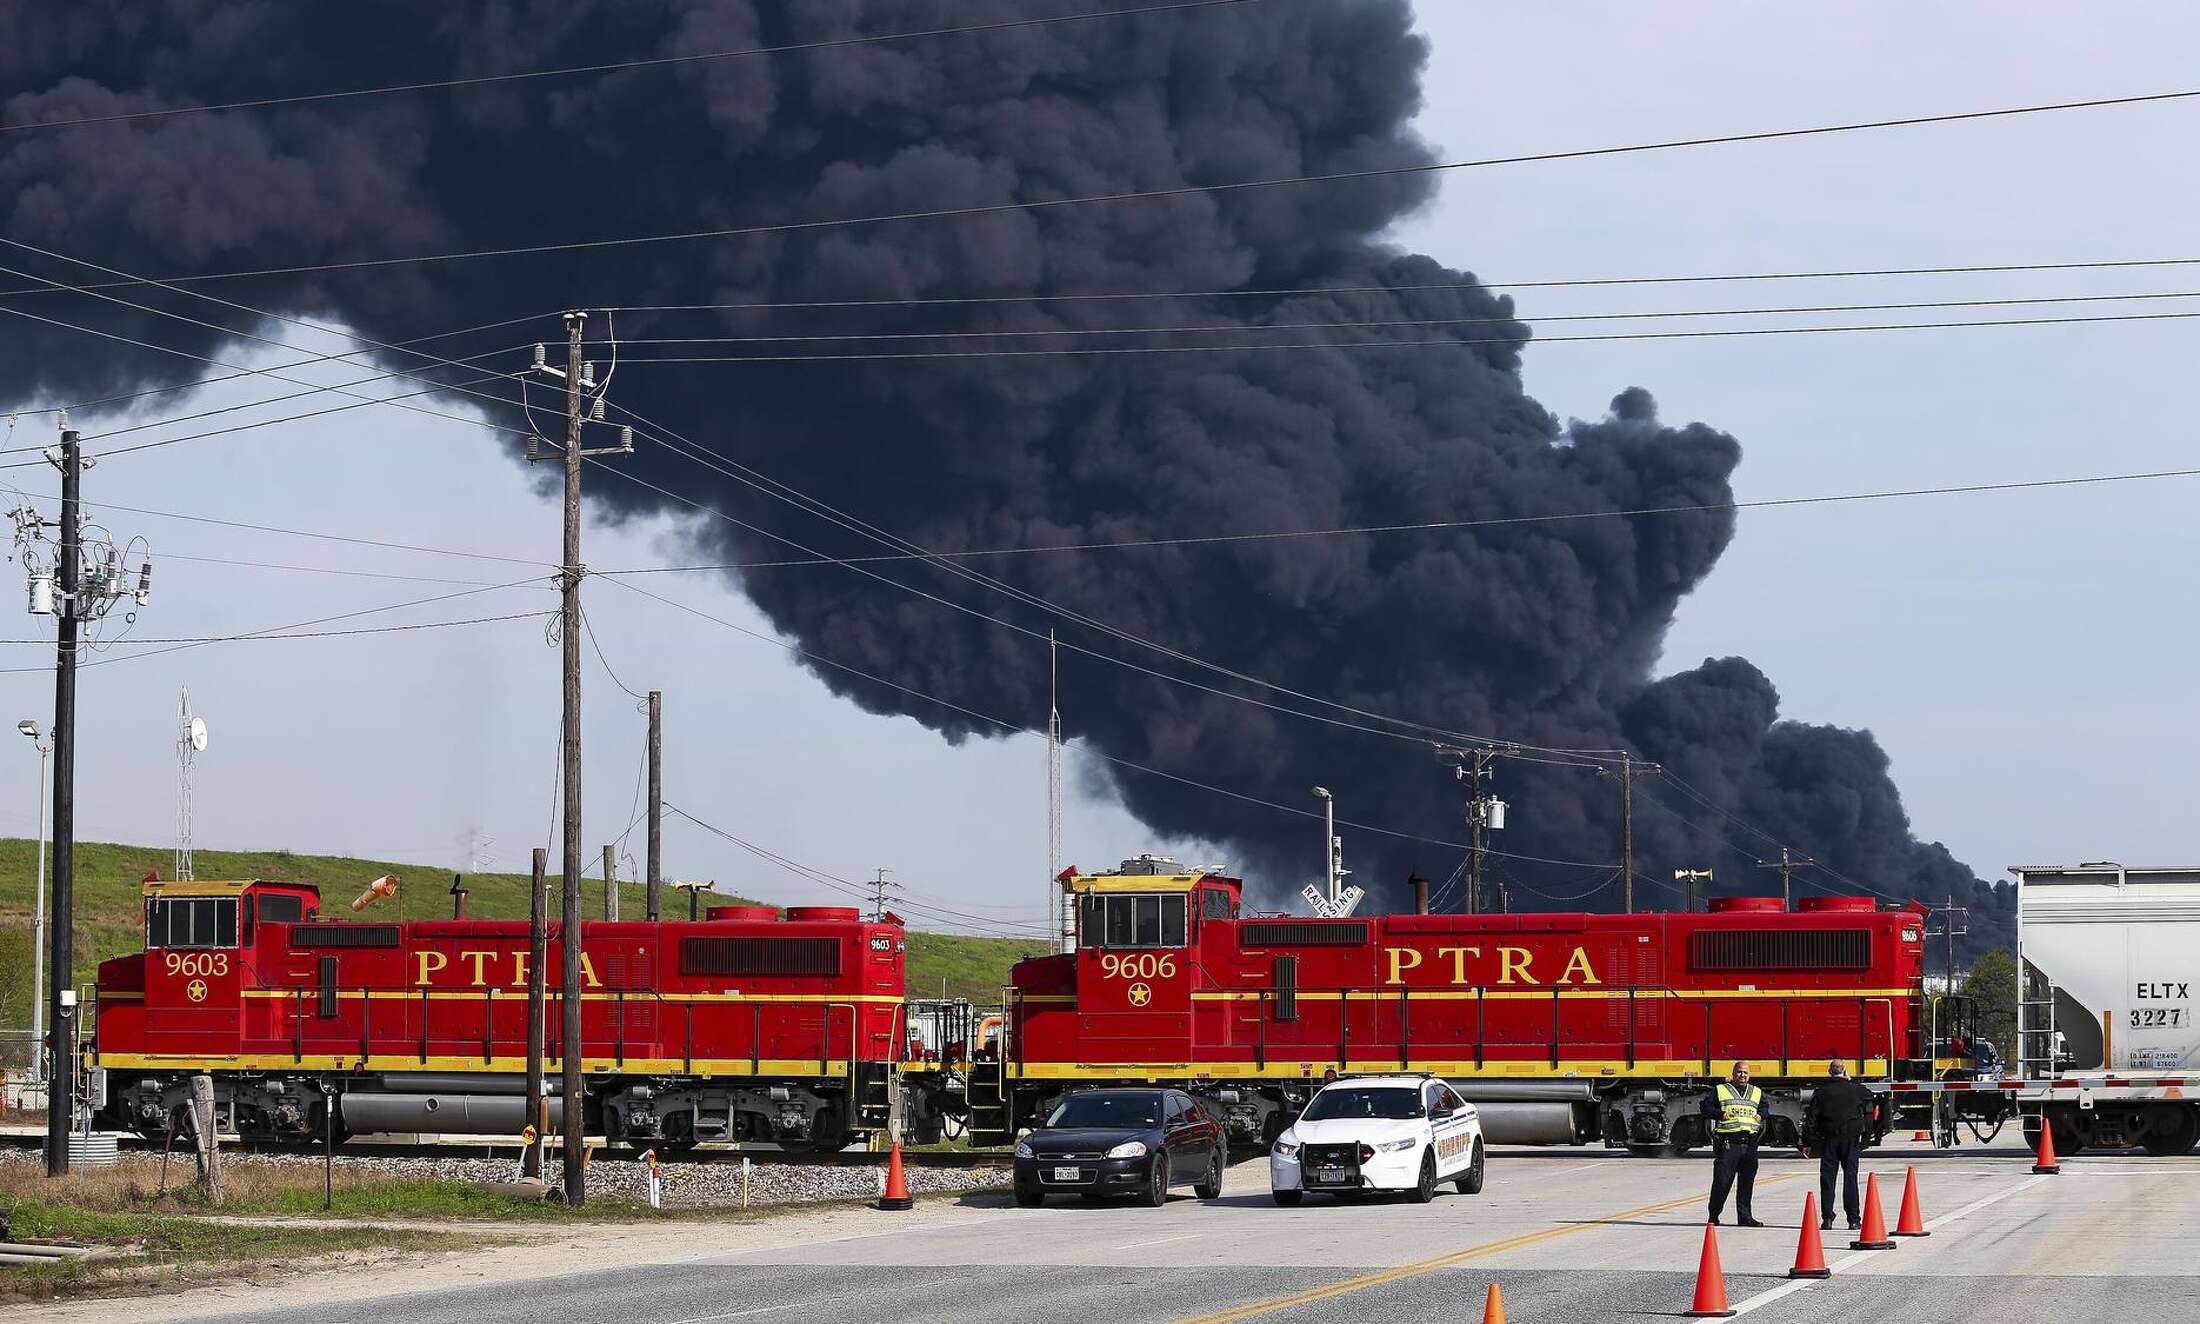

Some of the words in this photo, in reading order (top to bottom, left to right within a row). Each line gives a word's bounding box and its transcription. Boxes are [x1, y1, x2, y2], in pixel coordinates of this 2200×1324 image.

[871, 939, 890, 950] 9603
[1902, 929, 1917, 942] 9606
[166, 953, 228, 977] 9603
[1101, 953, 1176, 979] 9606
[1385, 946, 1602, 985] PTRA
[2137, 983, 2189, 999] ELTX
[2130, 1009, 2180, 1027] 3227
[1438, 1132, 1471, 1160] SHERIFF
